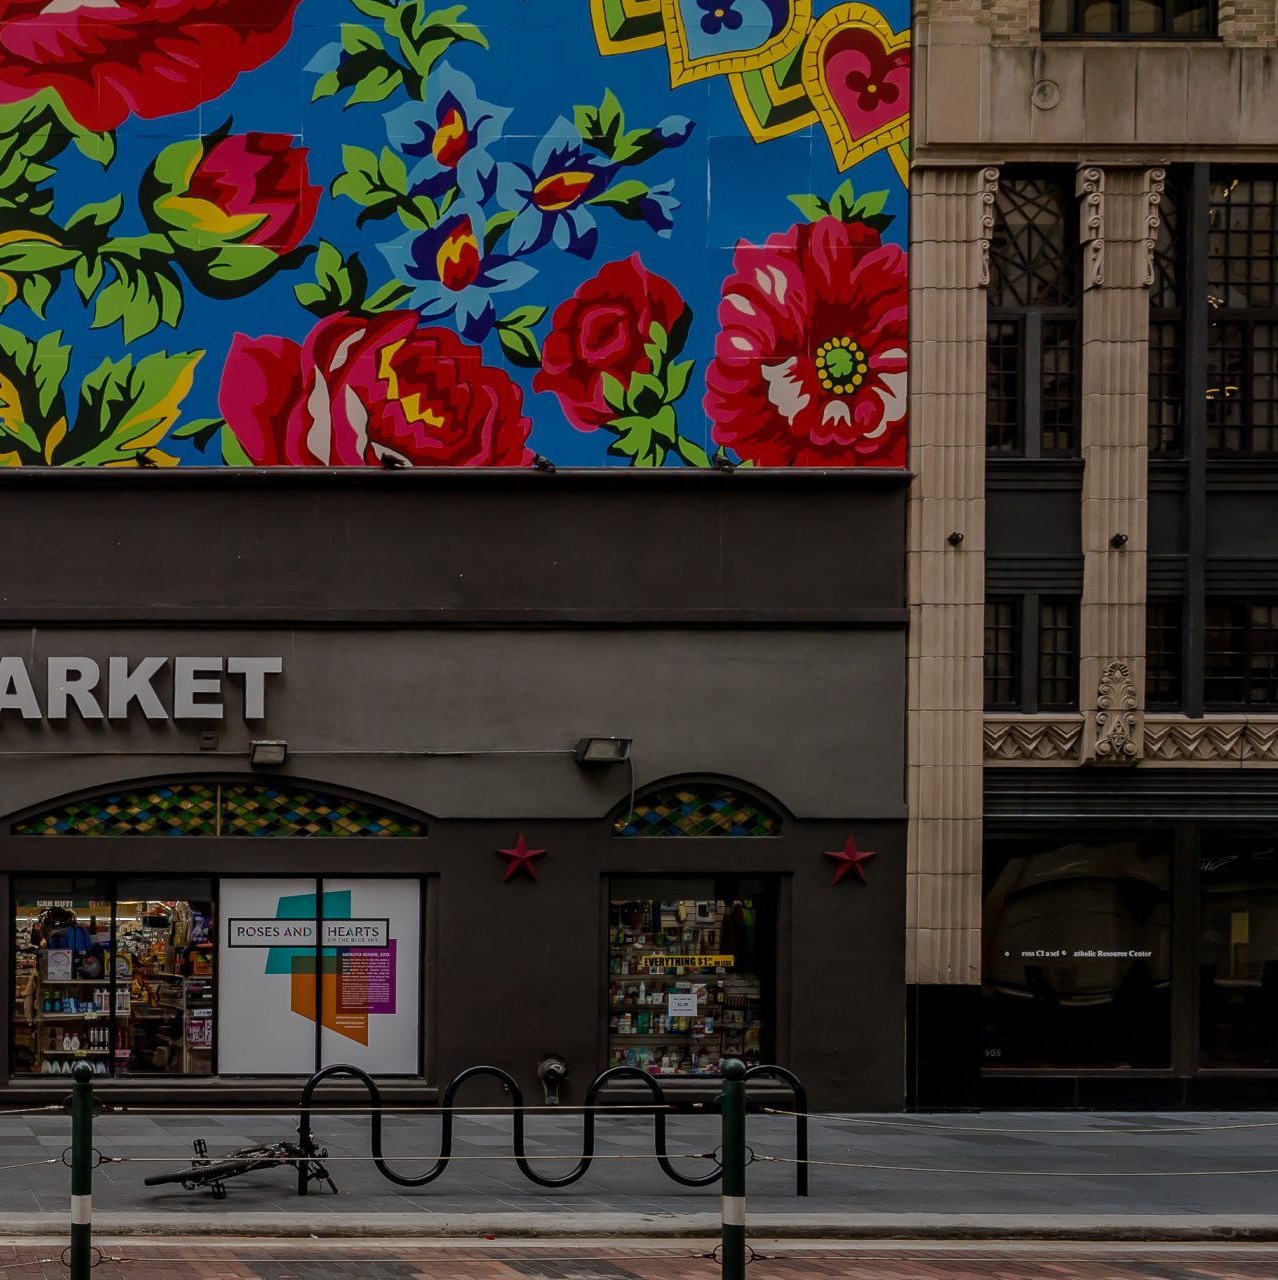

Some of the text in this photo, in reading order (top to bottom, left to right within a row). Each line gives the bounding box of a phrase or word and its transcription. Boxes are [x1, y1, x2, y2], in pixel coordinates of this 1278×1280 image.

[237, 926, 379, 937] ROSES AND HEARTS
[1073, 949, 1097, 957] atholic
[1097, 949, 1128, 957] Resource
[1128, 949, 1152, 957] Center
[644, 957, 696, 966] EVERYTHING
